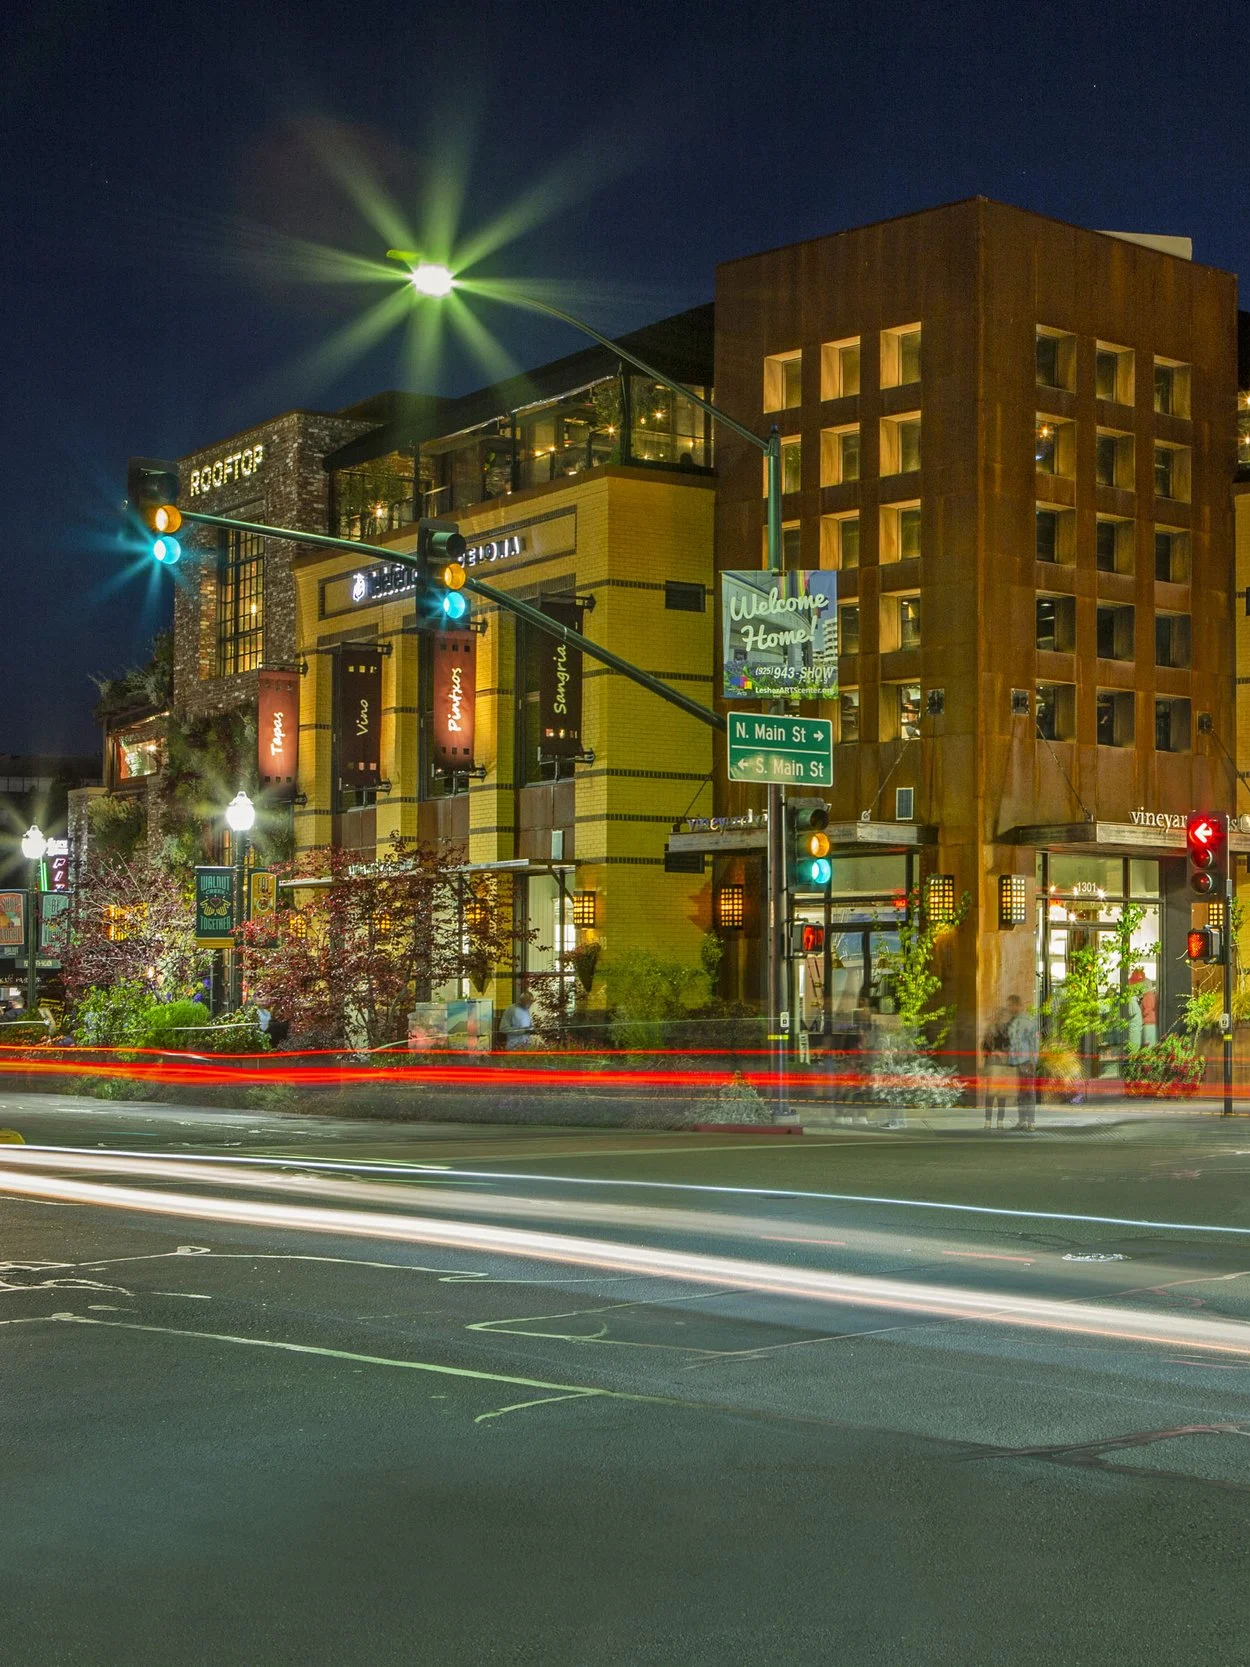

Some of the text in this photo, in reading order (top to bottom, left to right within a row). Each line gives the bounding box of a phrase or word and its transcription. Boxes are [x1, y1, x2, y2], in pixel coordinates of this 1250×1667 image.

[190, 444, 263, 497] ROOFTOP
[730, 587, 829, 621] Welcome
[741, 615, 818, 652] Home!
[553, 644, 570, 714] Sangria
[755, 686, 834, 696] LesherARTScenter.org
[448, 667, 463, 732] Pintxos
[356, 699, 369, 736] Vino
[736, 722, 807, 743] N. Main St
[271, 711, 284, 756] Tapas
[756, 757, 824, 777] S. Main St
[1129, 806, 1188, 833] vineyar
[200, 875, 231, 891] WALNUT
[1077, 881, 1096, 893] 1301
[200, 915, 231, 930] TOGETHER
